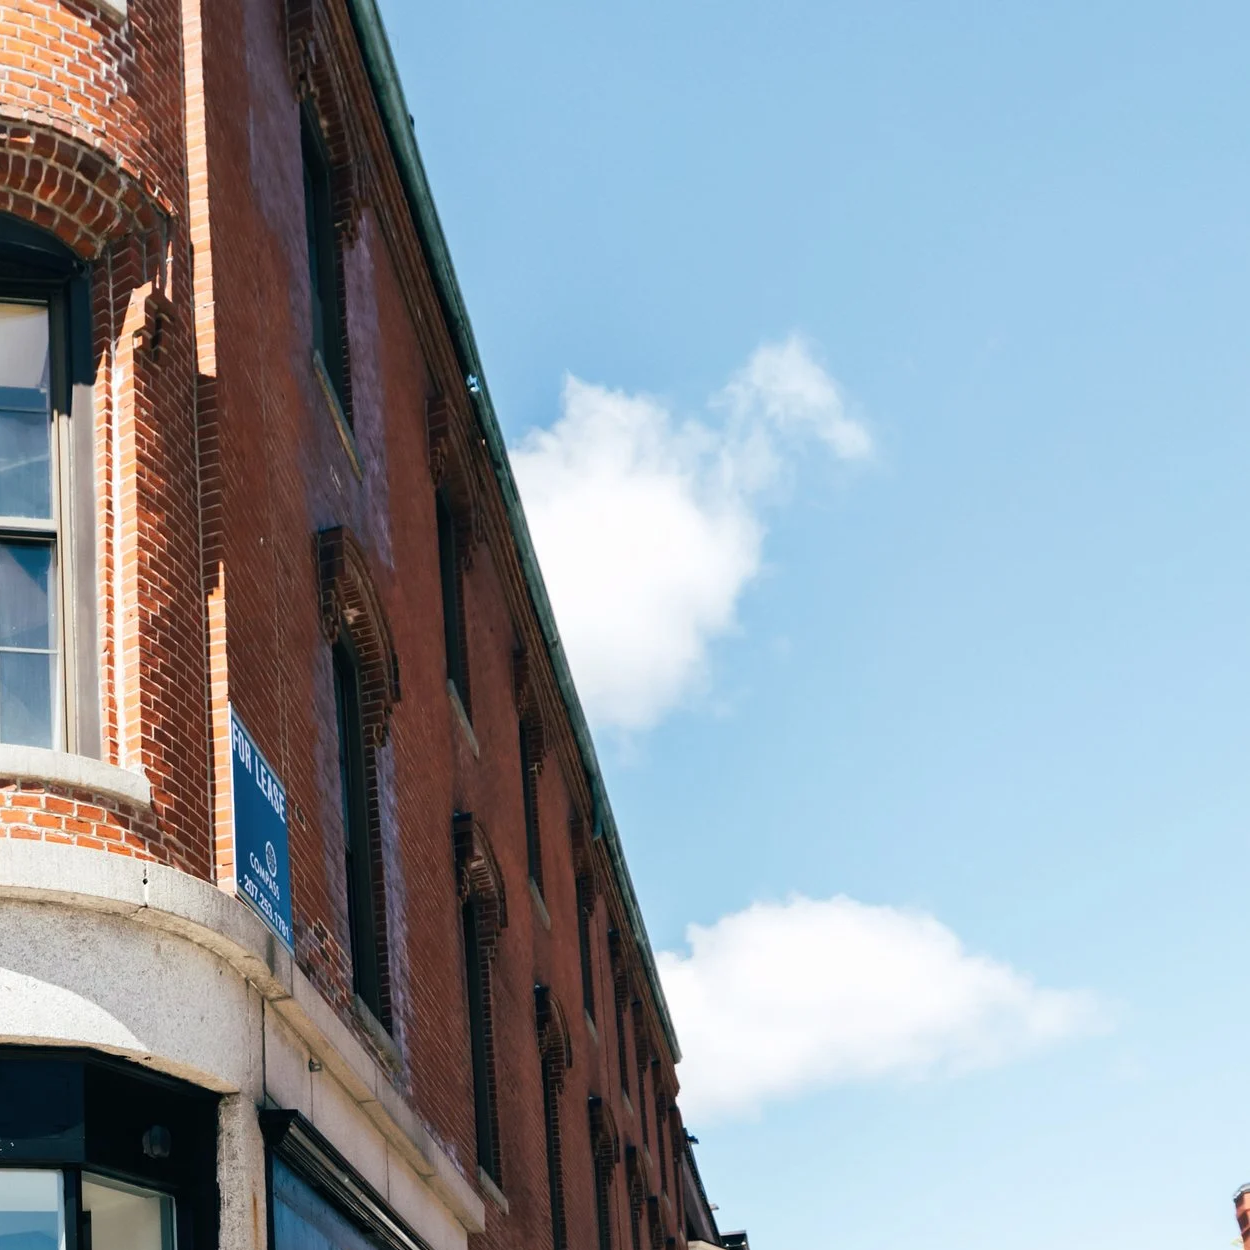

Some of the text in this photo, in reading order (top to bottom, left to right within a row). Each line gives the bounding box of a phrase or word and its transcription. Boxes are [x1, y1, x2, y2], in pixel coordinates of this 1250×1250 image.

[232, 720, 286, 824] FOR LEASE
[249, 851, 280, 901] COMPASS
